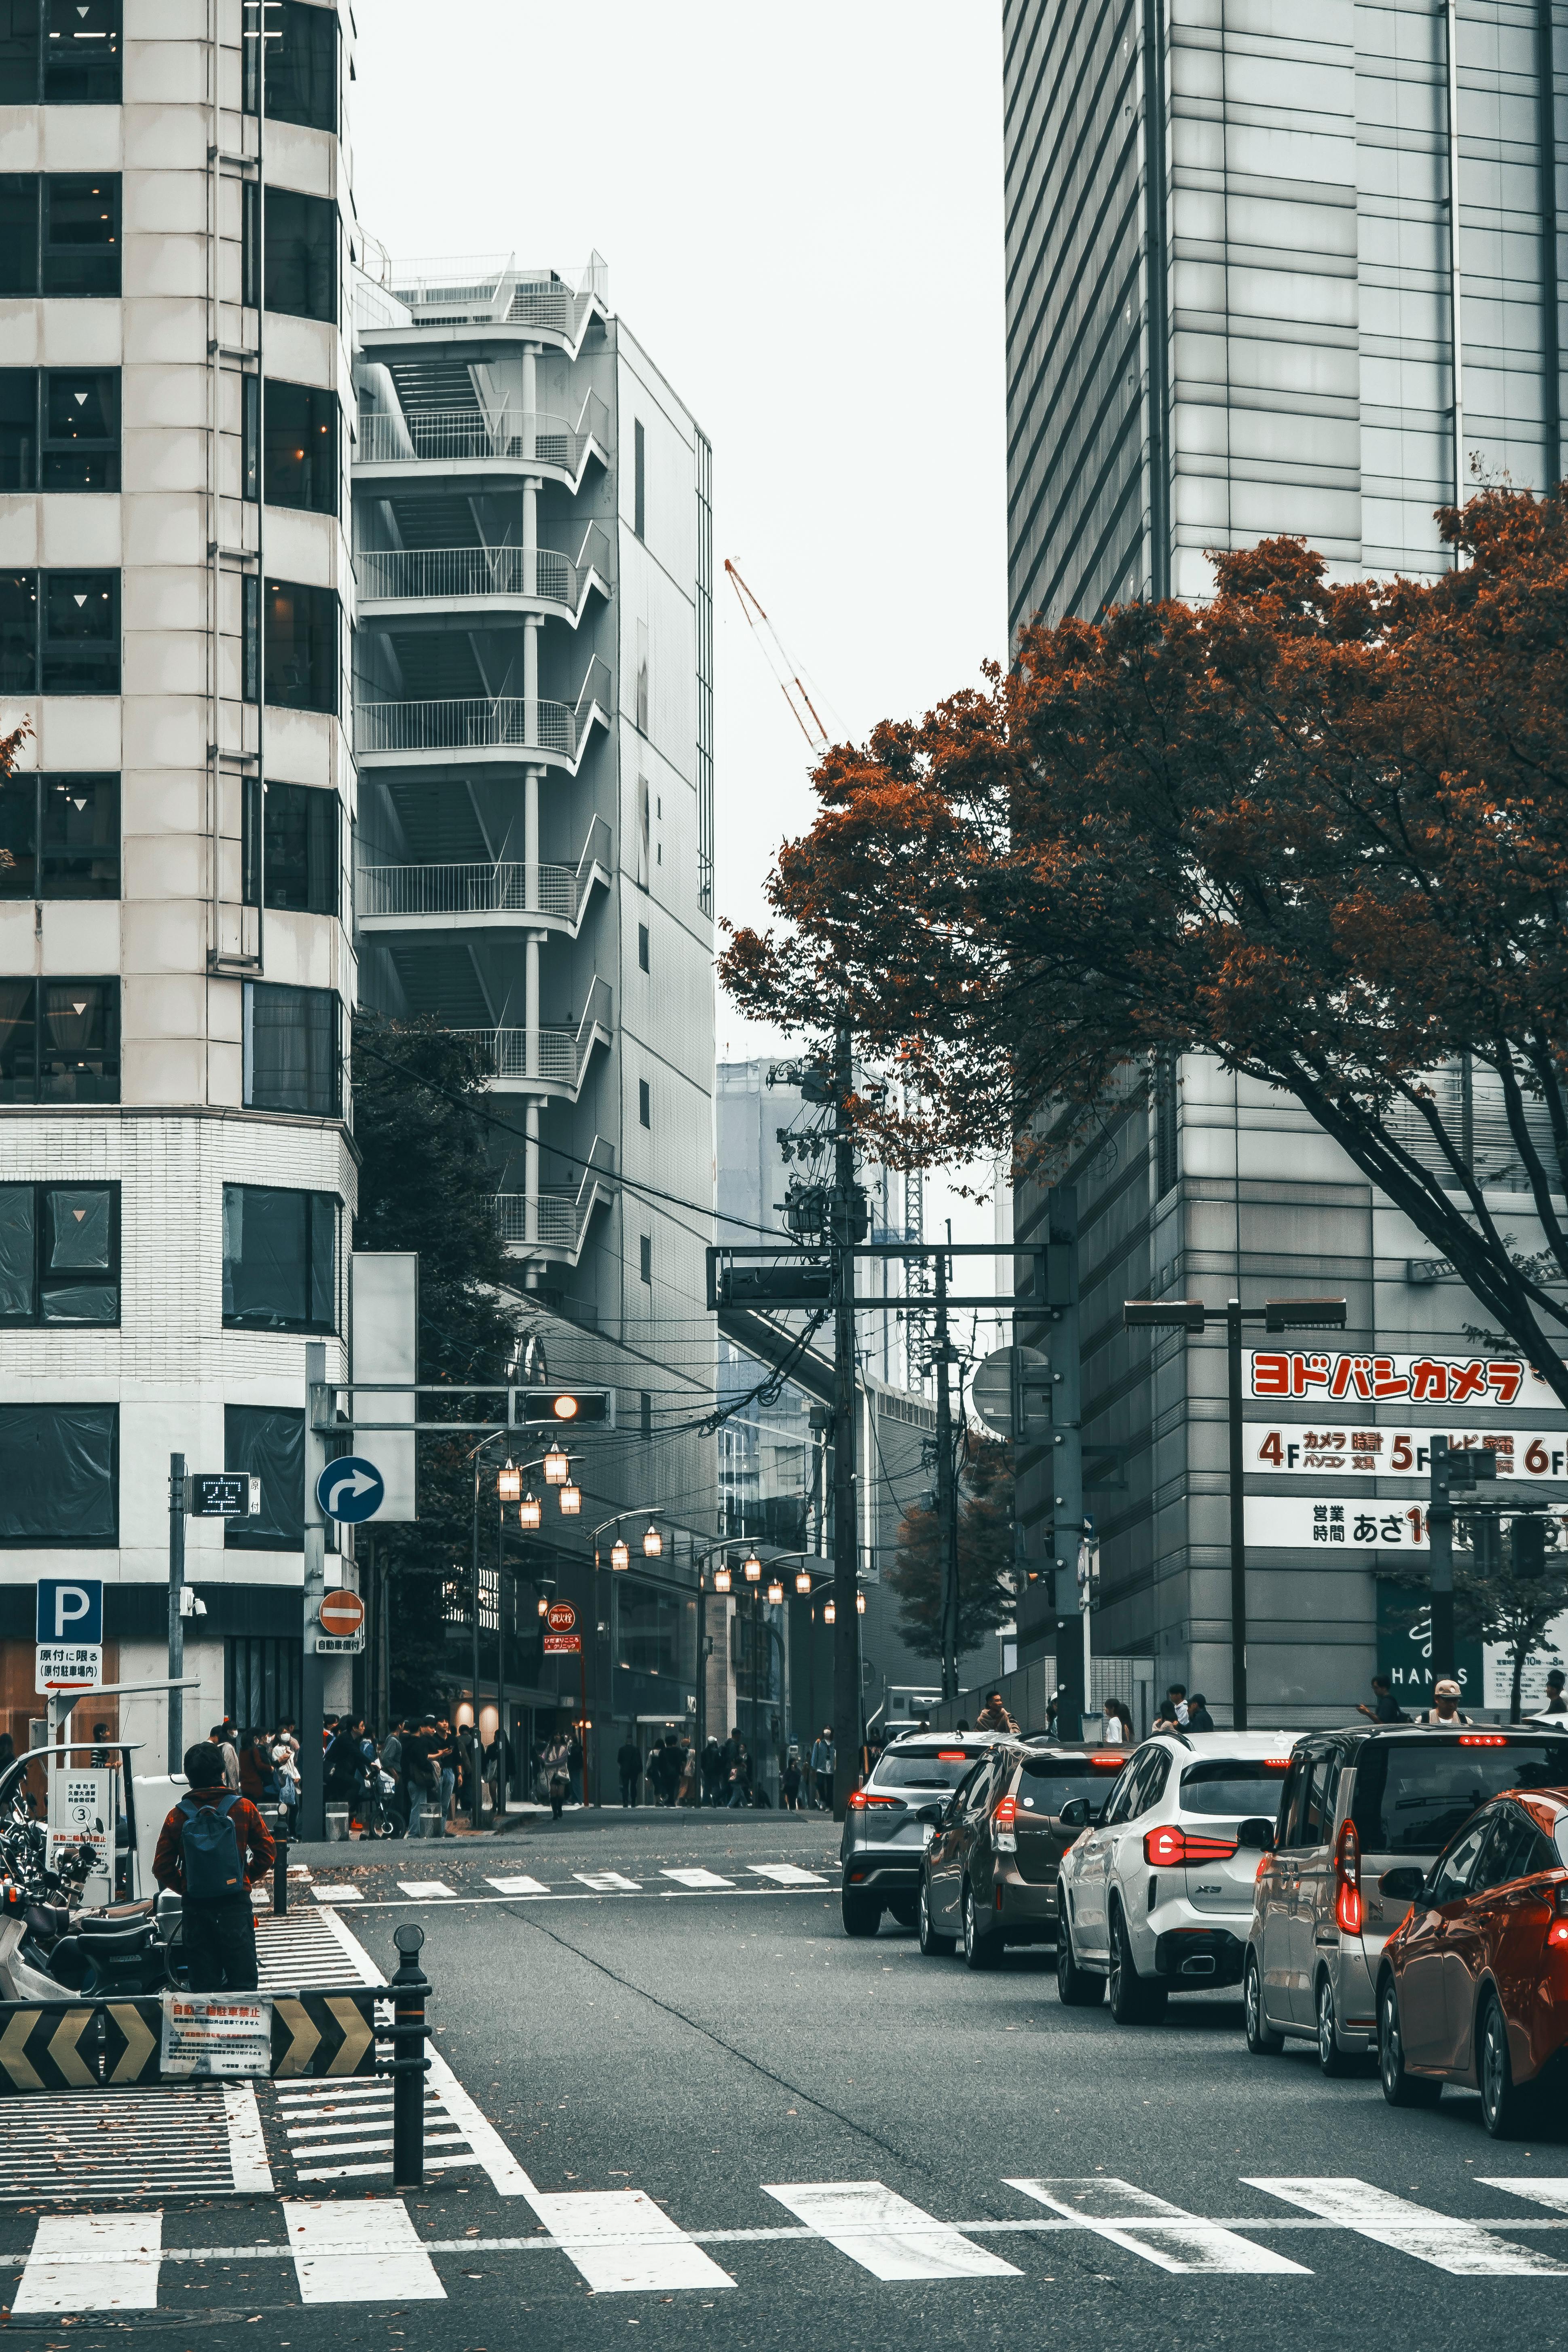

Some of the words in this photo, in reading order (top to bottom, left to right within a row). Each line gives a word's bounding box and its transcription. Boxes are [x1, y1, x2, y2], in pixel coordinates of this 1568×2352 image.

[1251, 1350, 1524, 1405] ヨドバシカメラ
[1257, 1430, 1300, 1469] 4F
[1303, 1431, 1347, 1450] カメラ
[1351, 1432, 1384, 1452] 時計
[1448, 1434, 1479, 1450] レビ
[1303, 1454, 1346, 1468] パソコン
[1351, 1455, 1376, 1470] 文具
[1524, 1437, 1564, 1475] 6F
[202, 1477, 241, 1513] 空
[251, 1480, 259, 1512] 原付
[1313, 1505, 1344, 1522] 営業
[1313, 1525, 1344, 1542] 時間
[55, 1586, 90, 1636] P
[551, 1613, 573, 1624] 消火栓
[40, 1649, 98, 1662] 原付に限る
[40, 1665, 98, 1678] (原付駐車場内)
[1392, 1668, 1467, 1684] HANS
[77, 1809, 86, 1821] 3
[174, 2004, 260, 2018] 自動二輪駐車禁止
